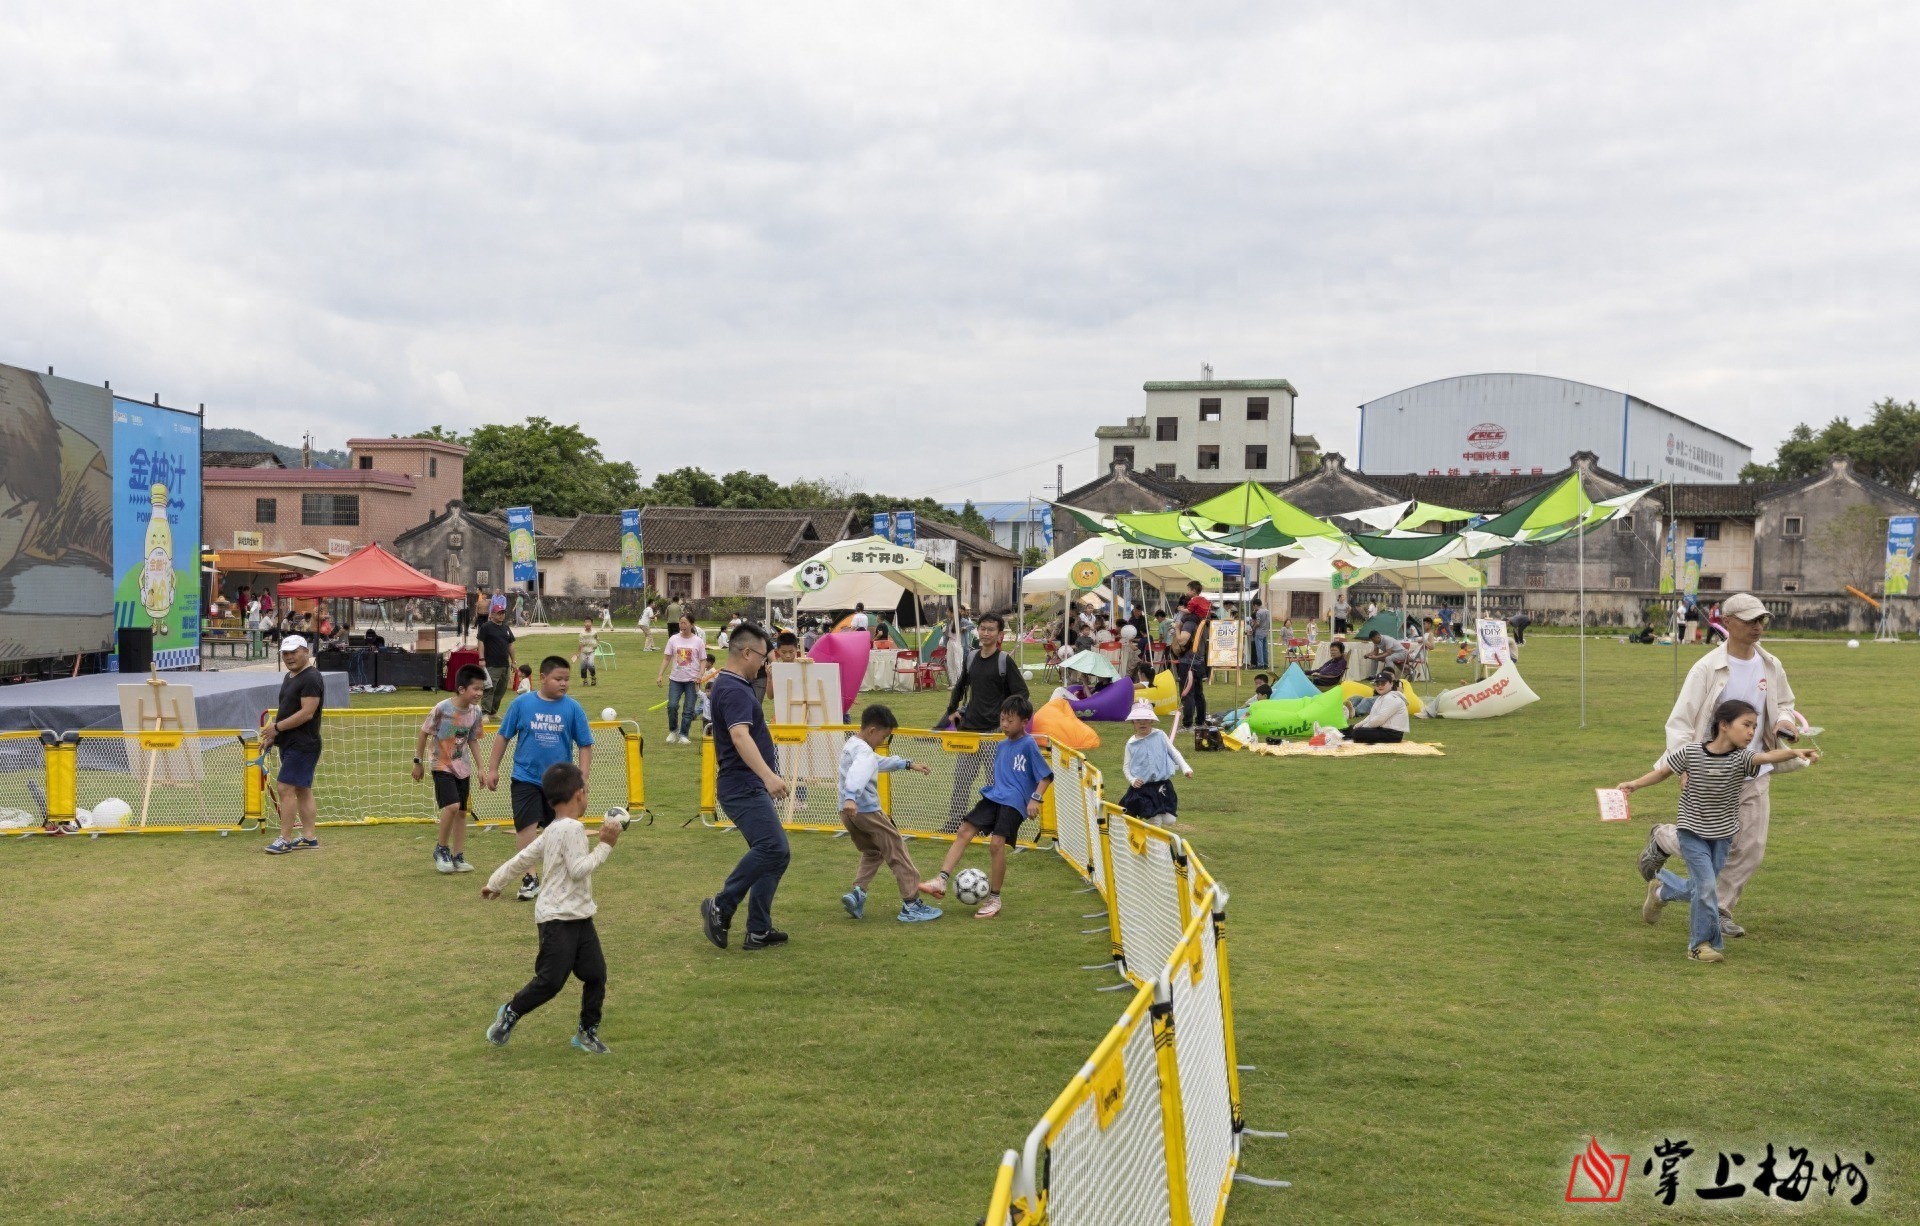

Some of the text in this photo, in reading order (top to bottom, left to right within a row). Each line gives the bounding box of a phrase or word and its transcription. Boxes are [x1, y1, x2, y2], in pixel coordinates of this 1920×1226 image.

[1463, 451, 1510, 461] 中国铁建
[129, 448, 186, 494] 金柚汁
[851, 551, 905, 564] 球个开心
[1122, 548, 1173, 560] 绘灯涂乐
[1217, 628, 1237, 636] DIY
[1484, 628, 1501, 636] DIY
[534, 712, 562, 723] WILD
[530, 721, 565, 732] NATURE
[1013, 754, 1027, 772] NY
